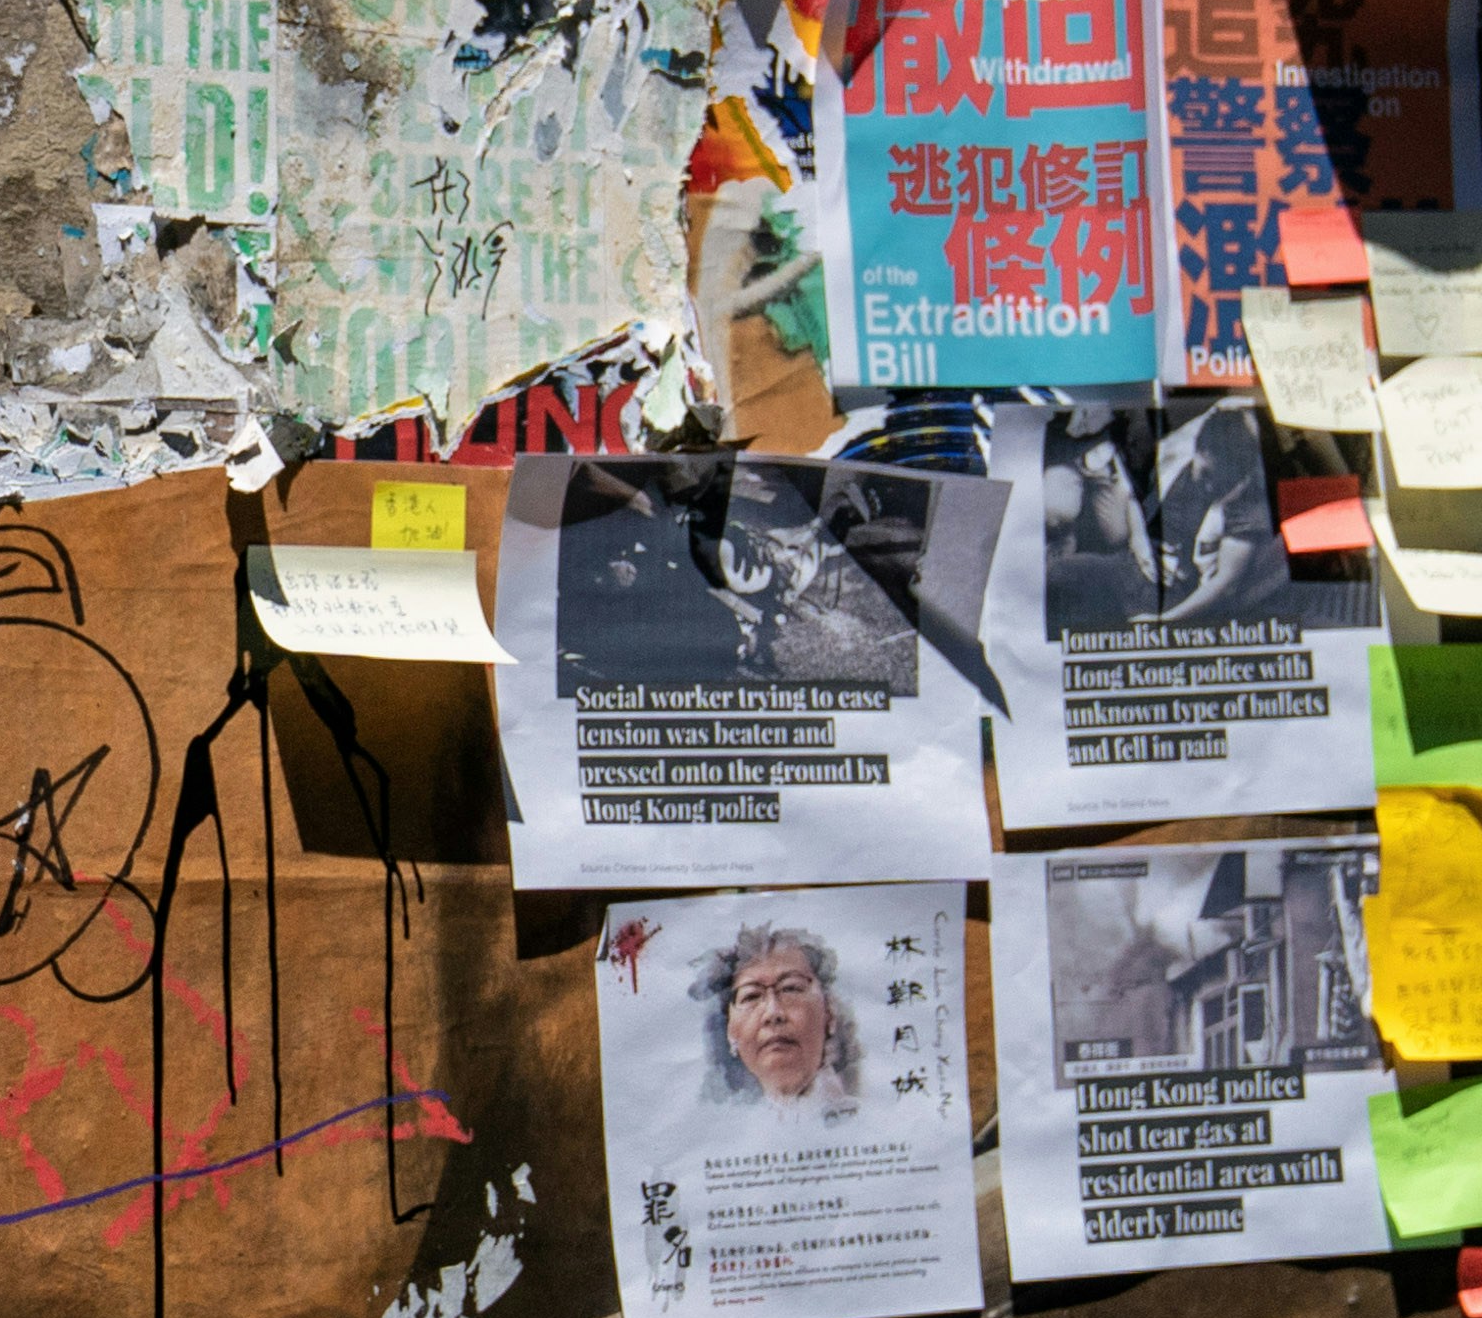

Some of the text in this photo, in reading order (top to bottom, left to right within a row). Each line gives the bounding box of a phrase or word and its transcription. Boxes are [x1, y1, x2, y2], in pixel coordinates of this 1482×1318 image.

[971, 53, 1133, 87] Withdrawal
[1275, 61, 1440, 92] Investigation
[864, 292, 1111, 339] Extradition
[866, 341, 938, 385] Bill
[576, 684, 644, 710] Social
[650, 685, 733, 709] worker
[738, 684, 806, 713] trying
[811, 685, 833, 708] to
[1078, 1074, 1299, 1111] Hong Kong police
[1078, 1117, 1266, 1152] shot tear gas at
